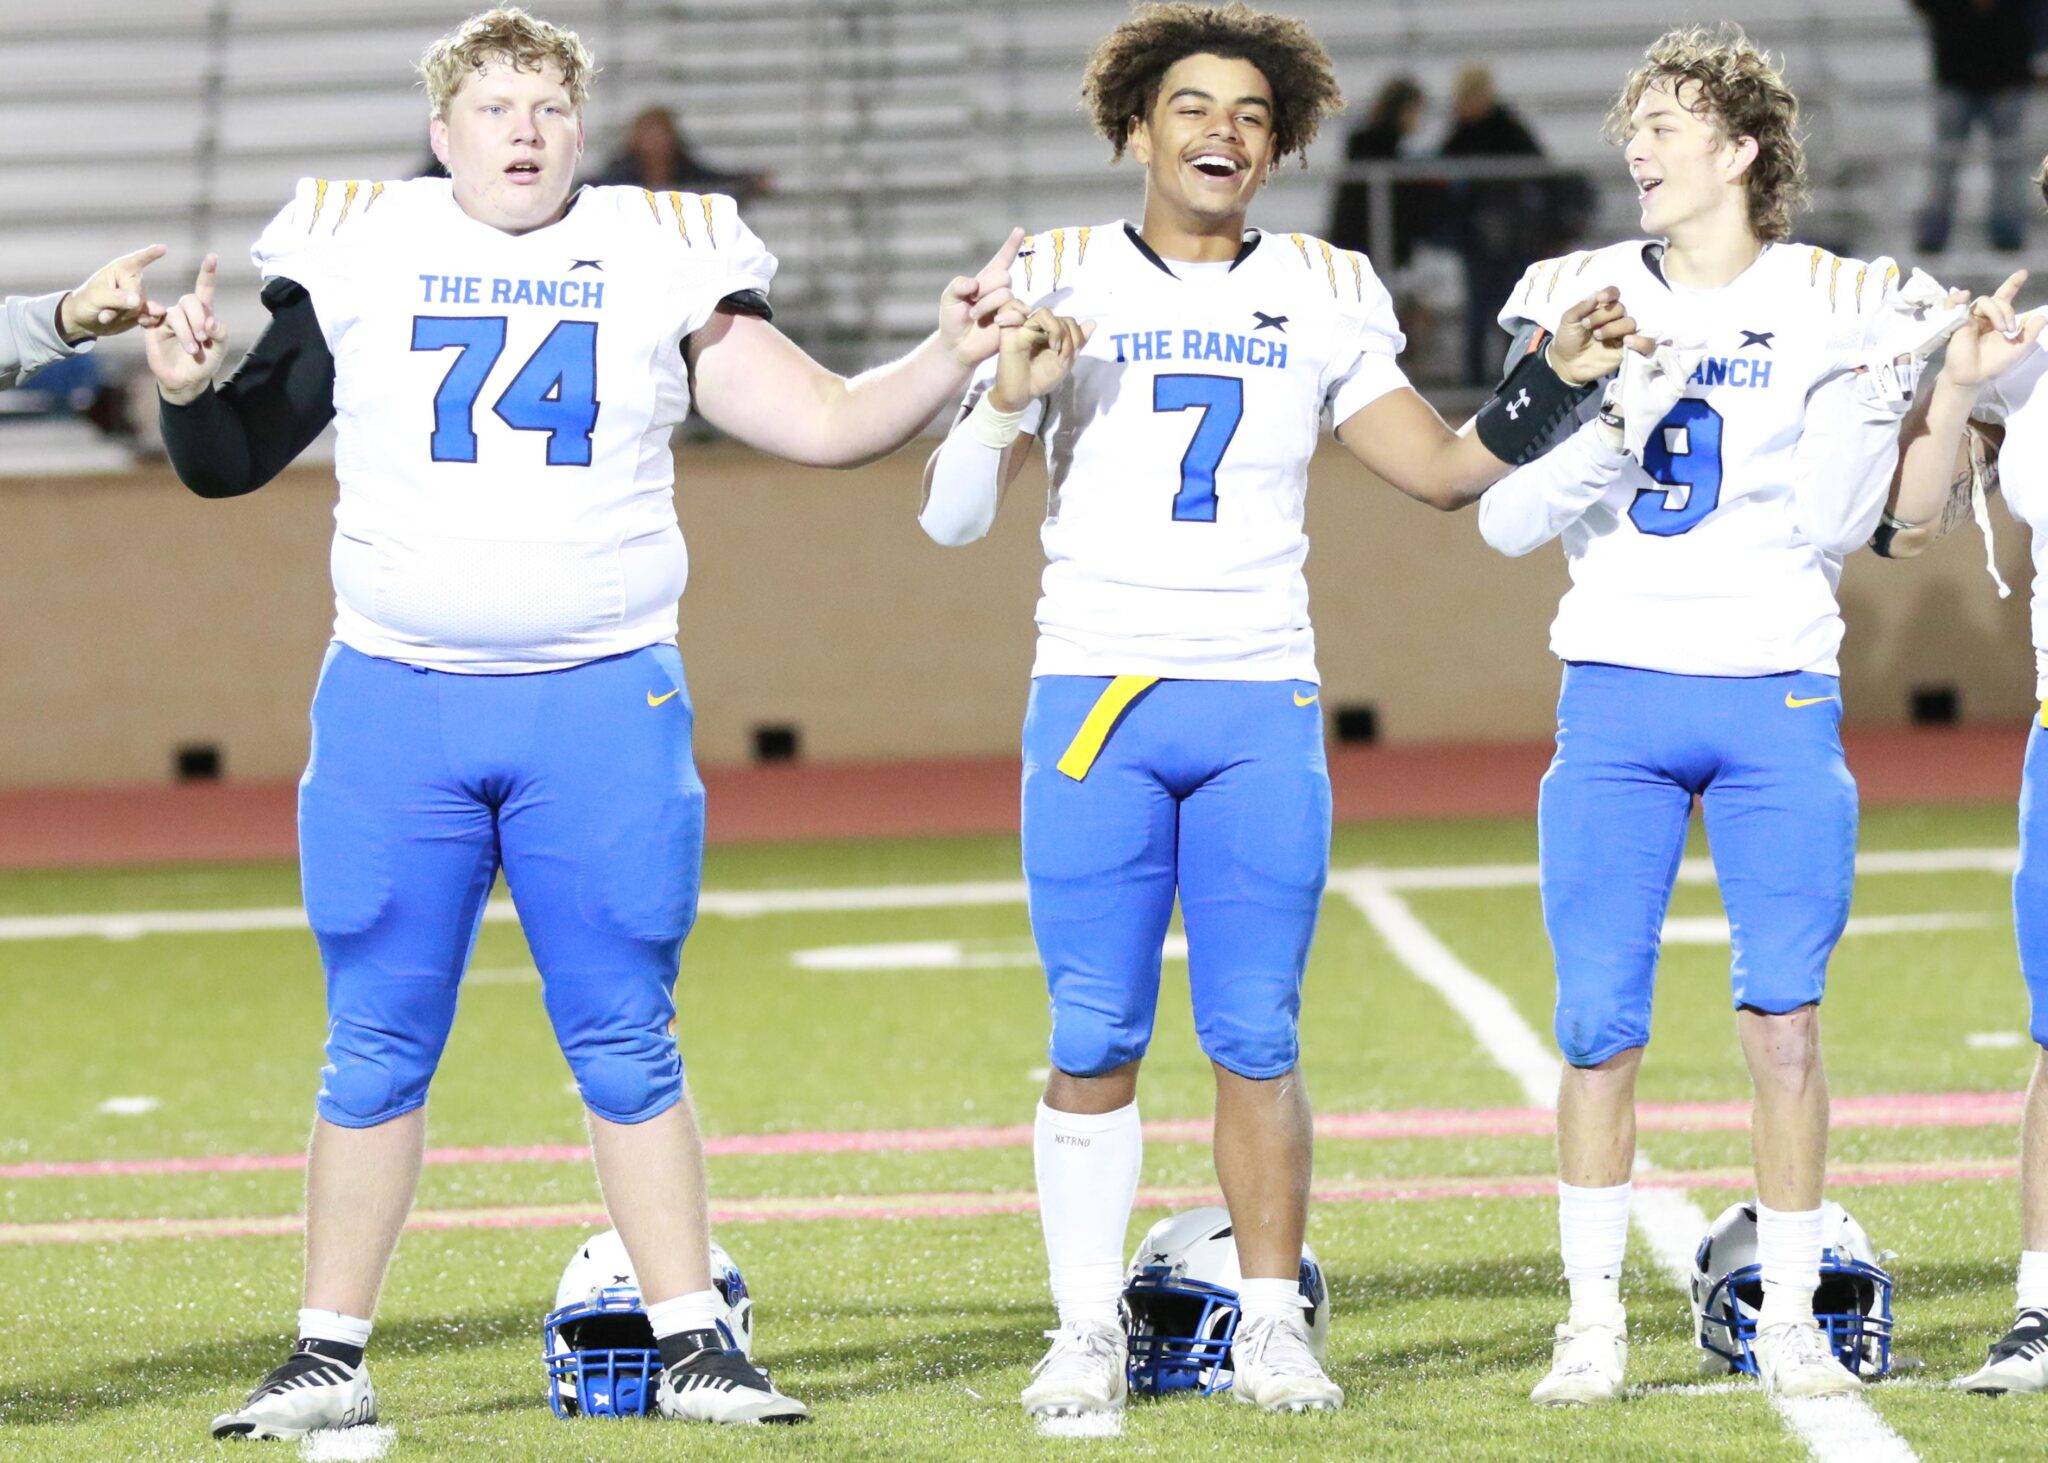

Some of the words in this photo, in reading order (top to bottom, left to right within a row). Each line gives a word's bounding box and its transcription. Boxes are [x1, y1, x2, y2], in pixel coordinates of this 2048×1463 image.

[418, 274, 481, 304] THE
[491, 278, 605, 309] RANCH
[410, 315, 601, 467] 74
[1110, 329, 1173, 365] THE
[1182, 329, 1288, 369] RANCH
[1685, 356, 1773, 389] ANCH
[1152, 373, 1244, 524] 7
[1625, 397, 1724, 538] 9
